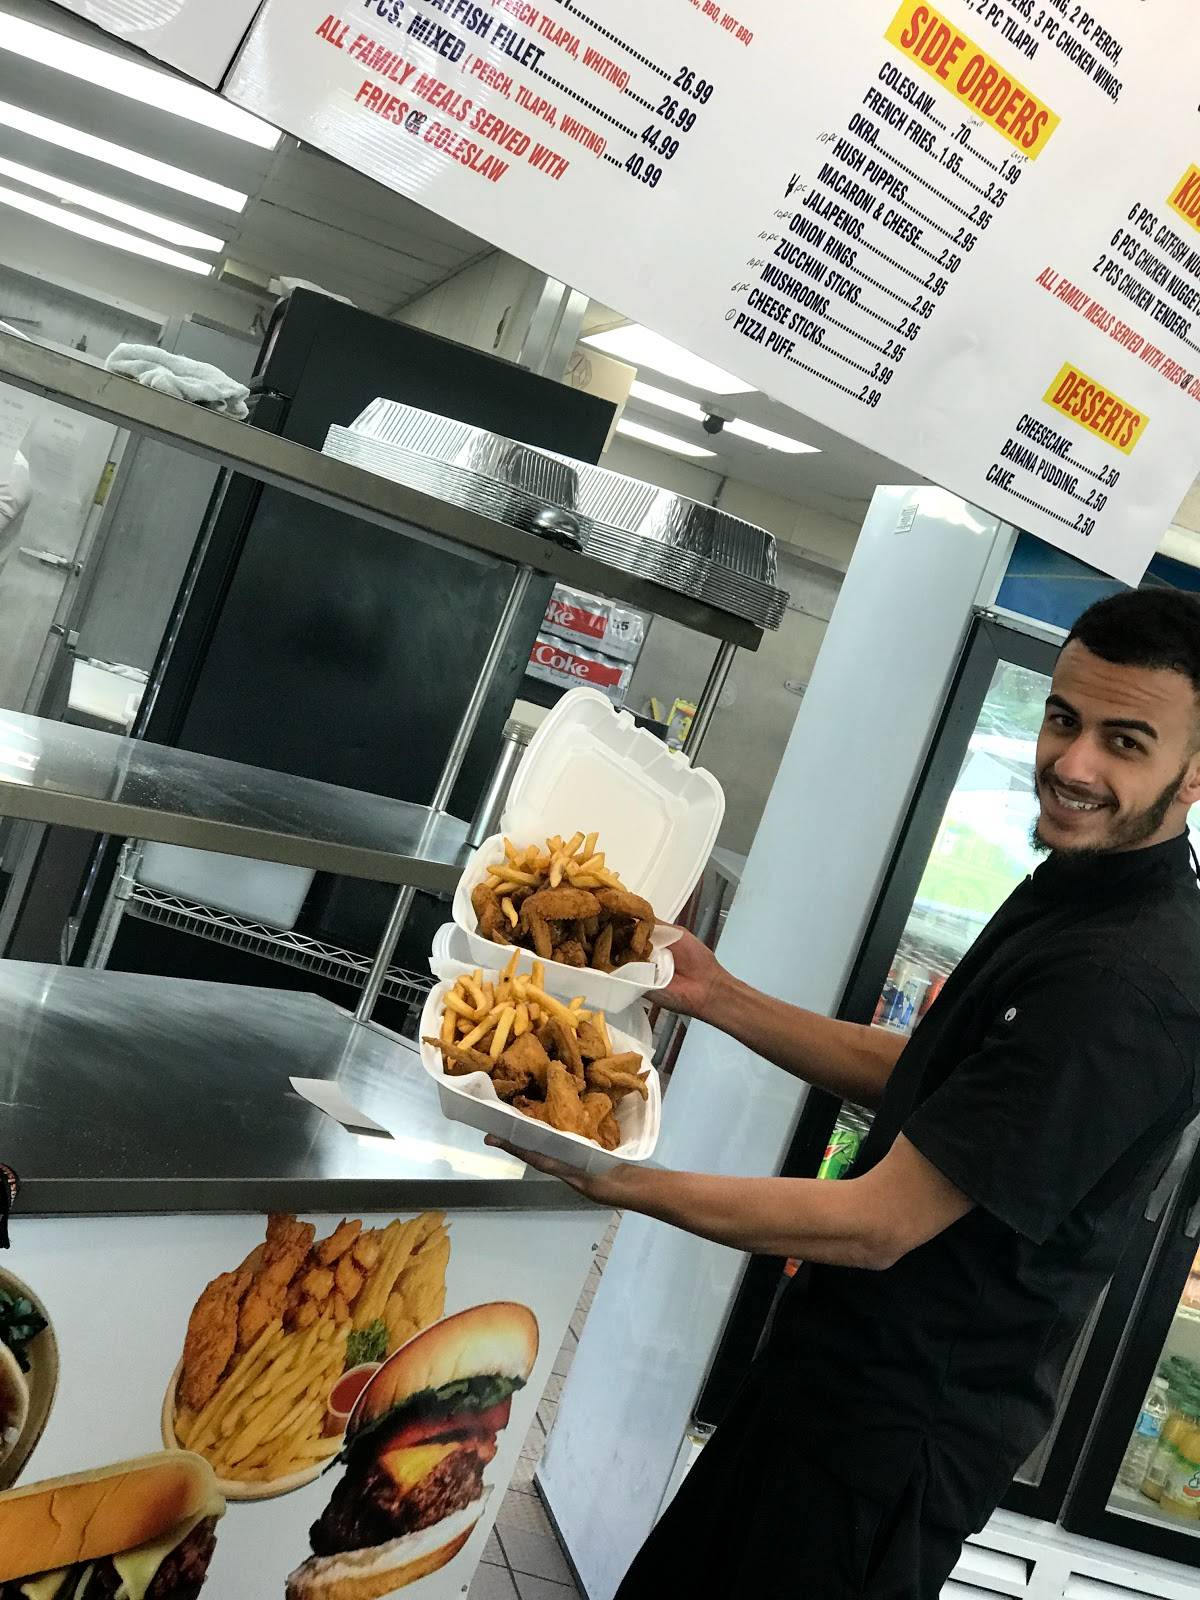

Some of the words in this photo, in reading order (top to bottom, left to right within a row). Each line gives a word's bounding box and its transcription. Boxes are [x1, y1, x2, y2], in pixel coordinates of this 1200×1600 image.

[537, 15, 581, 61] TILAPIA,
[581, 46, 631, 94] WHITING)
[655, 95, 697, 133] 26.99
[719, 13, 739, 33] HOT
[735, 25, 754, 47] BBQ
[900, 6, 967, 80] SIDE
[956, 54, 1049, 149] ORDERS
[984, 3, 1005, 28] PC
[1000, 16, 1040, 60] TILAPIA
[1033, 10, 1046, 28] 3
[1041, 16, 1060, 40] PC
[1055, 30, 1098, 76] CHICKEN
[1092, 63, 1123, 104] WINGS,
[1068, 5, 1081, 24] 2
[1076, 12, 1095, 36] PC
[1089, 24, 1124, 68] PERCH,
[315, 14, 350, 49] ALL
[347, 33, 417, 86] FAMILY
[411, 73, 473, 122] MEALS
[469, 107, 531, 157] SERVED
[527, 142, 570, 181] WITH
[354, 79, 410, 126] FRIES
[423, 121, 510, 183] COLESLAW
[406, 13, 466, 63] MIXED
[514, 85, 558, 129] TILAPIA,
[559, 114, 607, 159] WHITING)
[624, 152, 663, 189] 40.99
[490, 22, 546, 71] FILLET
[640, 124, 680, 160] 44.99
[672, 66, 714, 105] 26.99
[878, 61, 937, 116] COLESLAW
[951, 122, 972, 146] .70
[998, 158, 1022, 185] 1.99
[831, 137, 867, 172] HUSH
[862, 158, 909, 203] PUPPIES
[952, 227, 978, 252] 2.95
[847, 112, 881, 147] OKRA
[968, 204, 993, 230] 2.95
[862, 86, 909, 131] FRENCH
[903, 118, 937, 154] FRIES
[938, 146, 964, 174] 1.85
[983, 181, 1008, 209] 3.25
[788, 213, 827, 248] ONION
[822, 235, 858, 269] RINGS
[910, 295, 936, 319] 2.95
[802, 189, 865, 240] JALAPENOS
[923, 272, 949, 297] 2.95
[817, 162, 877, 214] MACARONI
[872, 202, 885, 221] &
[882, 209, 924, 247] CHEESE
[936, 248, 961, 274] 2.50
[1110, 228, 1124, 247] 6
[1117, 233, 1141, 261] PCS
[1134, 248, 1172, 287] CHICKEN
[1127, 202, 1141, 221] 6
[1134, 207, 1159, 238] PCS.
[1153, 225, 1191, 263] CATFISH
[747, 288, 792, 325] CHEESE
[788, 312, 826, 345] STICKS
[870, 362, 894, 385] 3.99
[760, 263, 831, 316] MUSHROOMS
[881, 339, 907, 363] 2.95
[773, 238, 829, 283] ZUCCHINI
[823, 270, 862, 304] STICKS
[896, 317, 921, 341] 2.95
[1035, 266, 1059, 291] ALL
[1052, 278, 1092, 313] FAMILY
[1082, 301, 1116, 333] MEALS
[1109, 320, 1145, 354] SERVED
[1138, 342, 1166, 369] WITH
[1157, 358, 1187, 385] FRIES
[1092, 254, 1106, 272] 2
[1099, 259, 1124, 286] PCS
[1117, 273, 1156, 312] CHICKEN
[1149, 298, 1192, 340] TENDERS
[733, 312, 768, 344] PIZZA
[764, 330, 796, 358] PUFF
[858, 385, 882, 408] 2.99
[1051, 370, 1141, 447] DESSERTS
[1000, 438, 1040, 473] BANANA
[1035, 458, 1079, 495] PUDDING
[1085, 488, 1108, 512] 2.50
[1015, 413, 1073, 459] CHEESECAKE
[1097, 464, 1121, 488] 2.50
[985, 463, 1016, 491] CAKE
[1072, 513, 1096, 537] 2.50
[536, 646, 589, 677] Coke
[545, 603, 576, 626] ke
